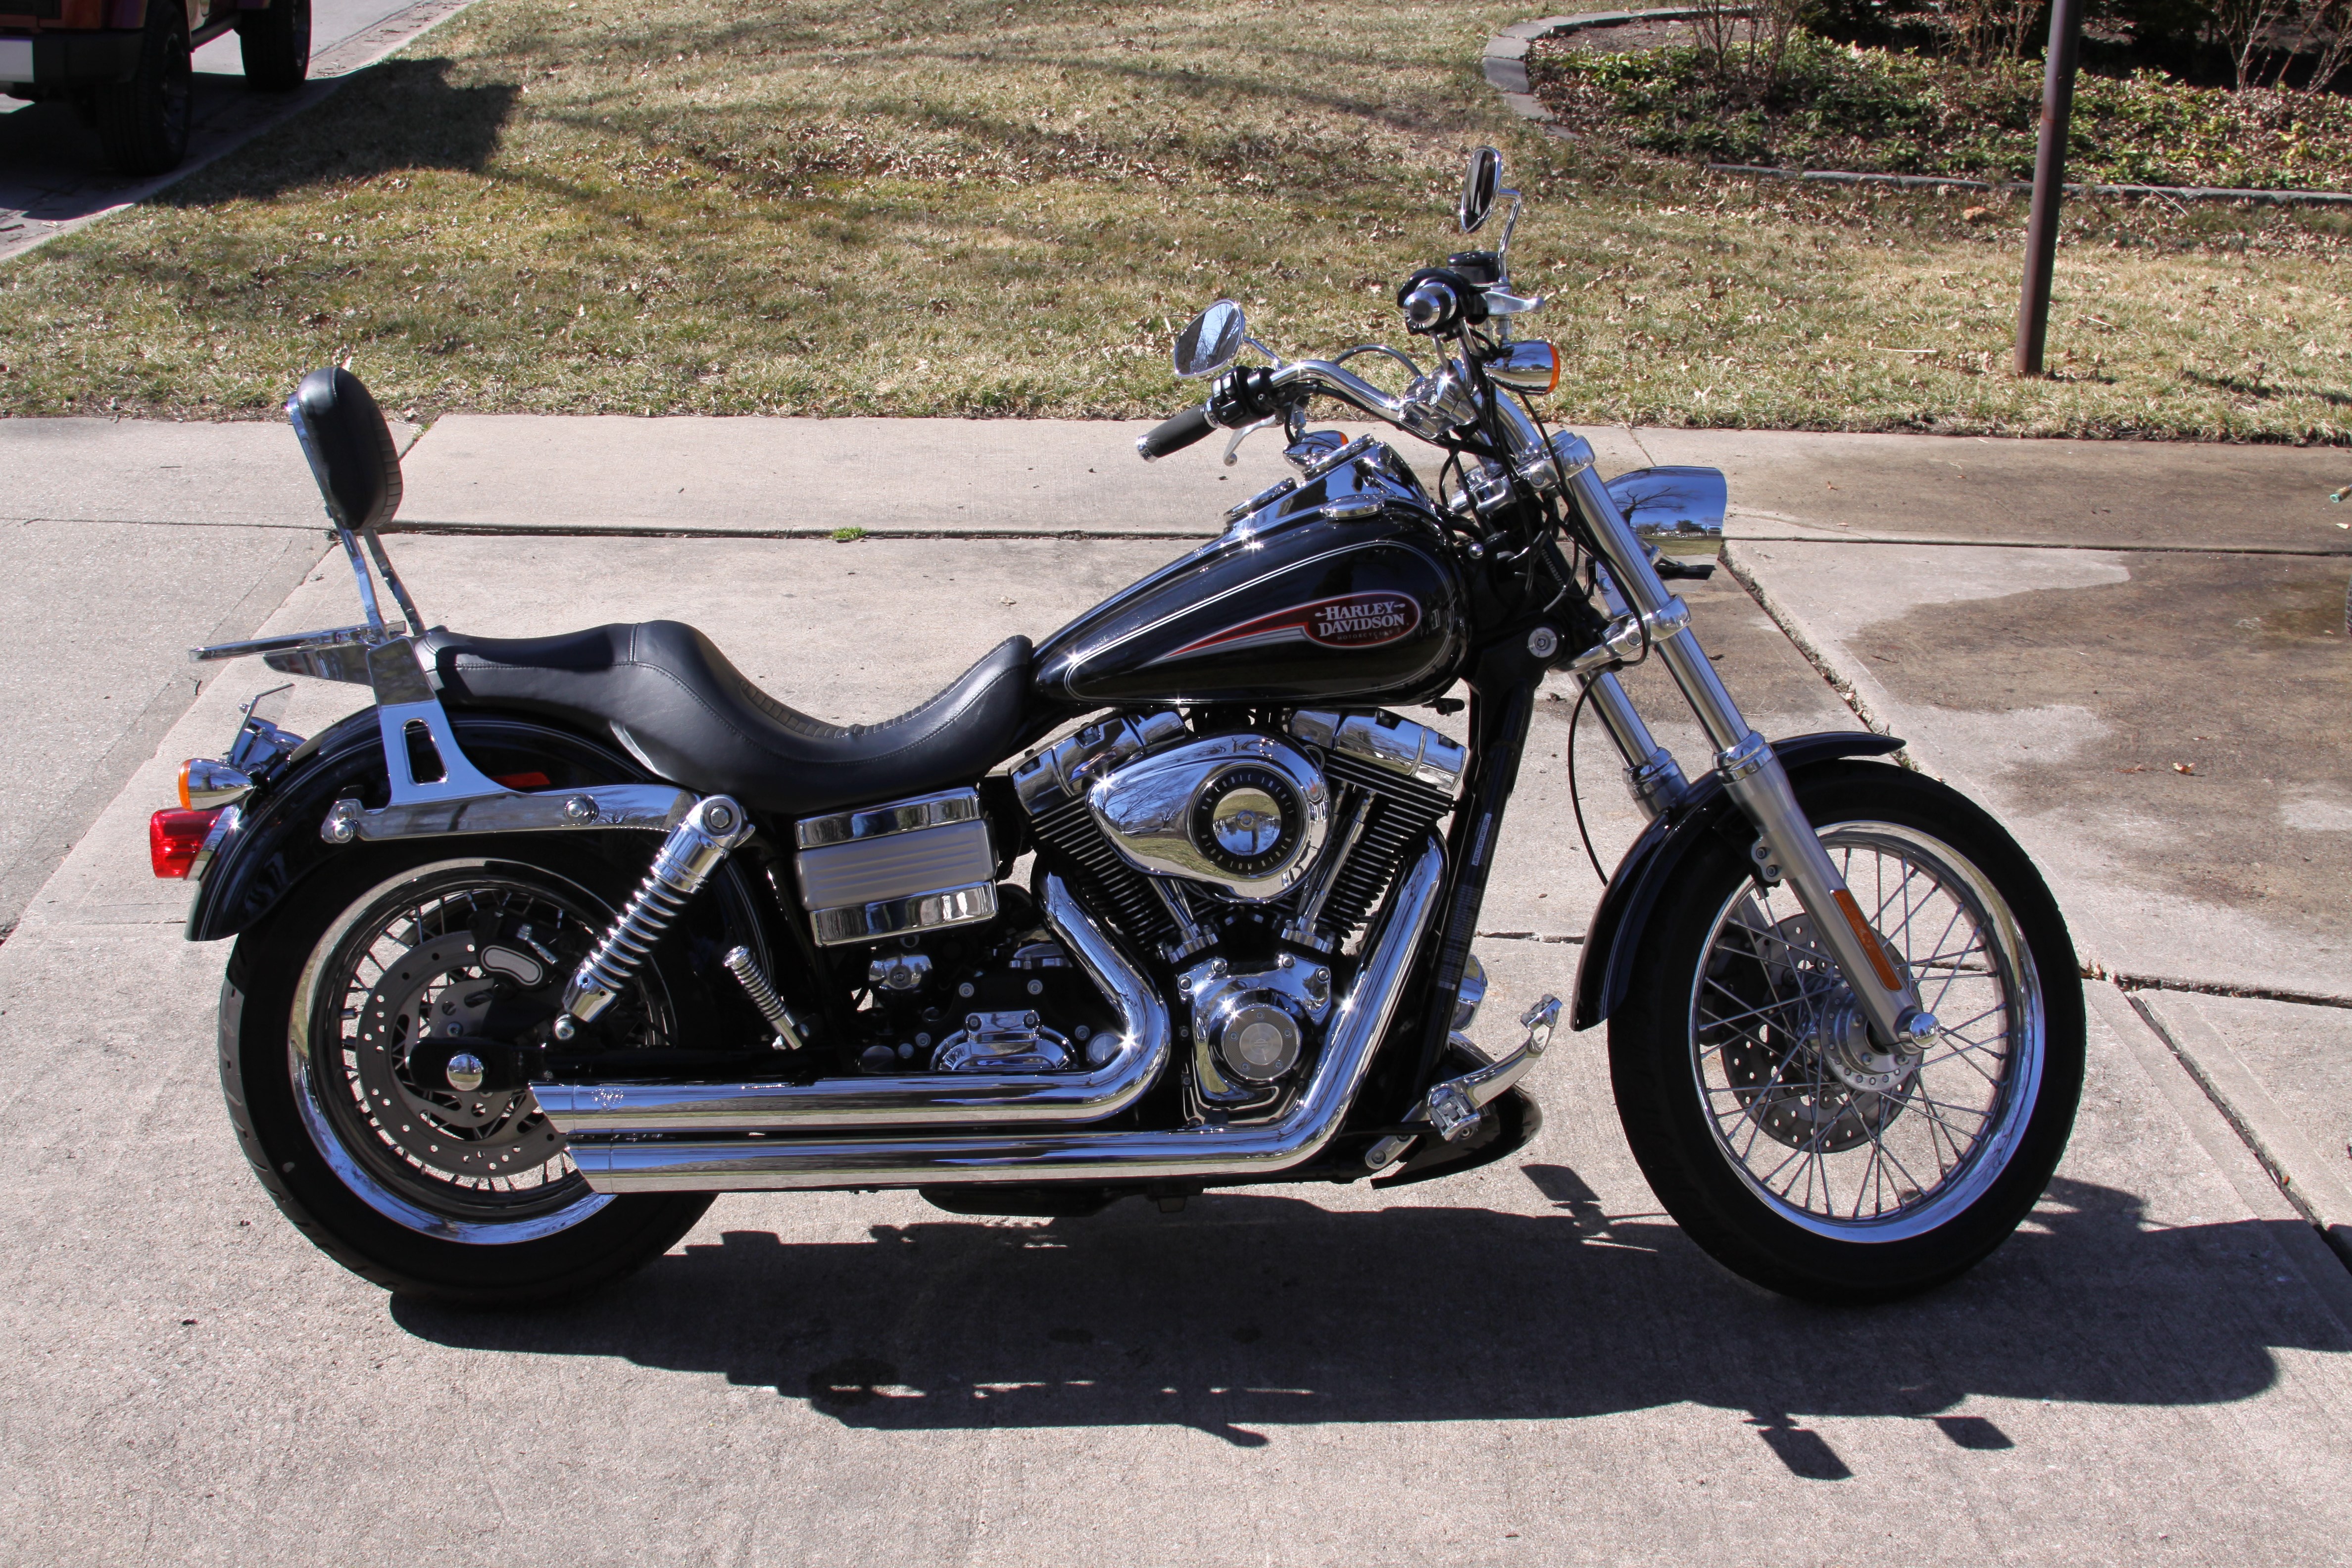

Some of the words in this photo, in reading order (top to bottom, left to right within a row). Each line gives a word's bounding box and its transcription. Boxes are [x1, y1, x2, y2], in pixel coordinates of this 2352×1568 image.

[1318, 613, 1405, 637] DAVIDSON
[1337, 630, 1393, 640] MOTORCYCLS
[1215, 774, 1251, 792] CUBIC
[1261, 777, 1294, 814] INCHES
[1201, 834, 1223, 861] DYNA
[1230, 861, 1252, 870] LOW
[1261, 837, 1292, 867] RIDER
